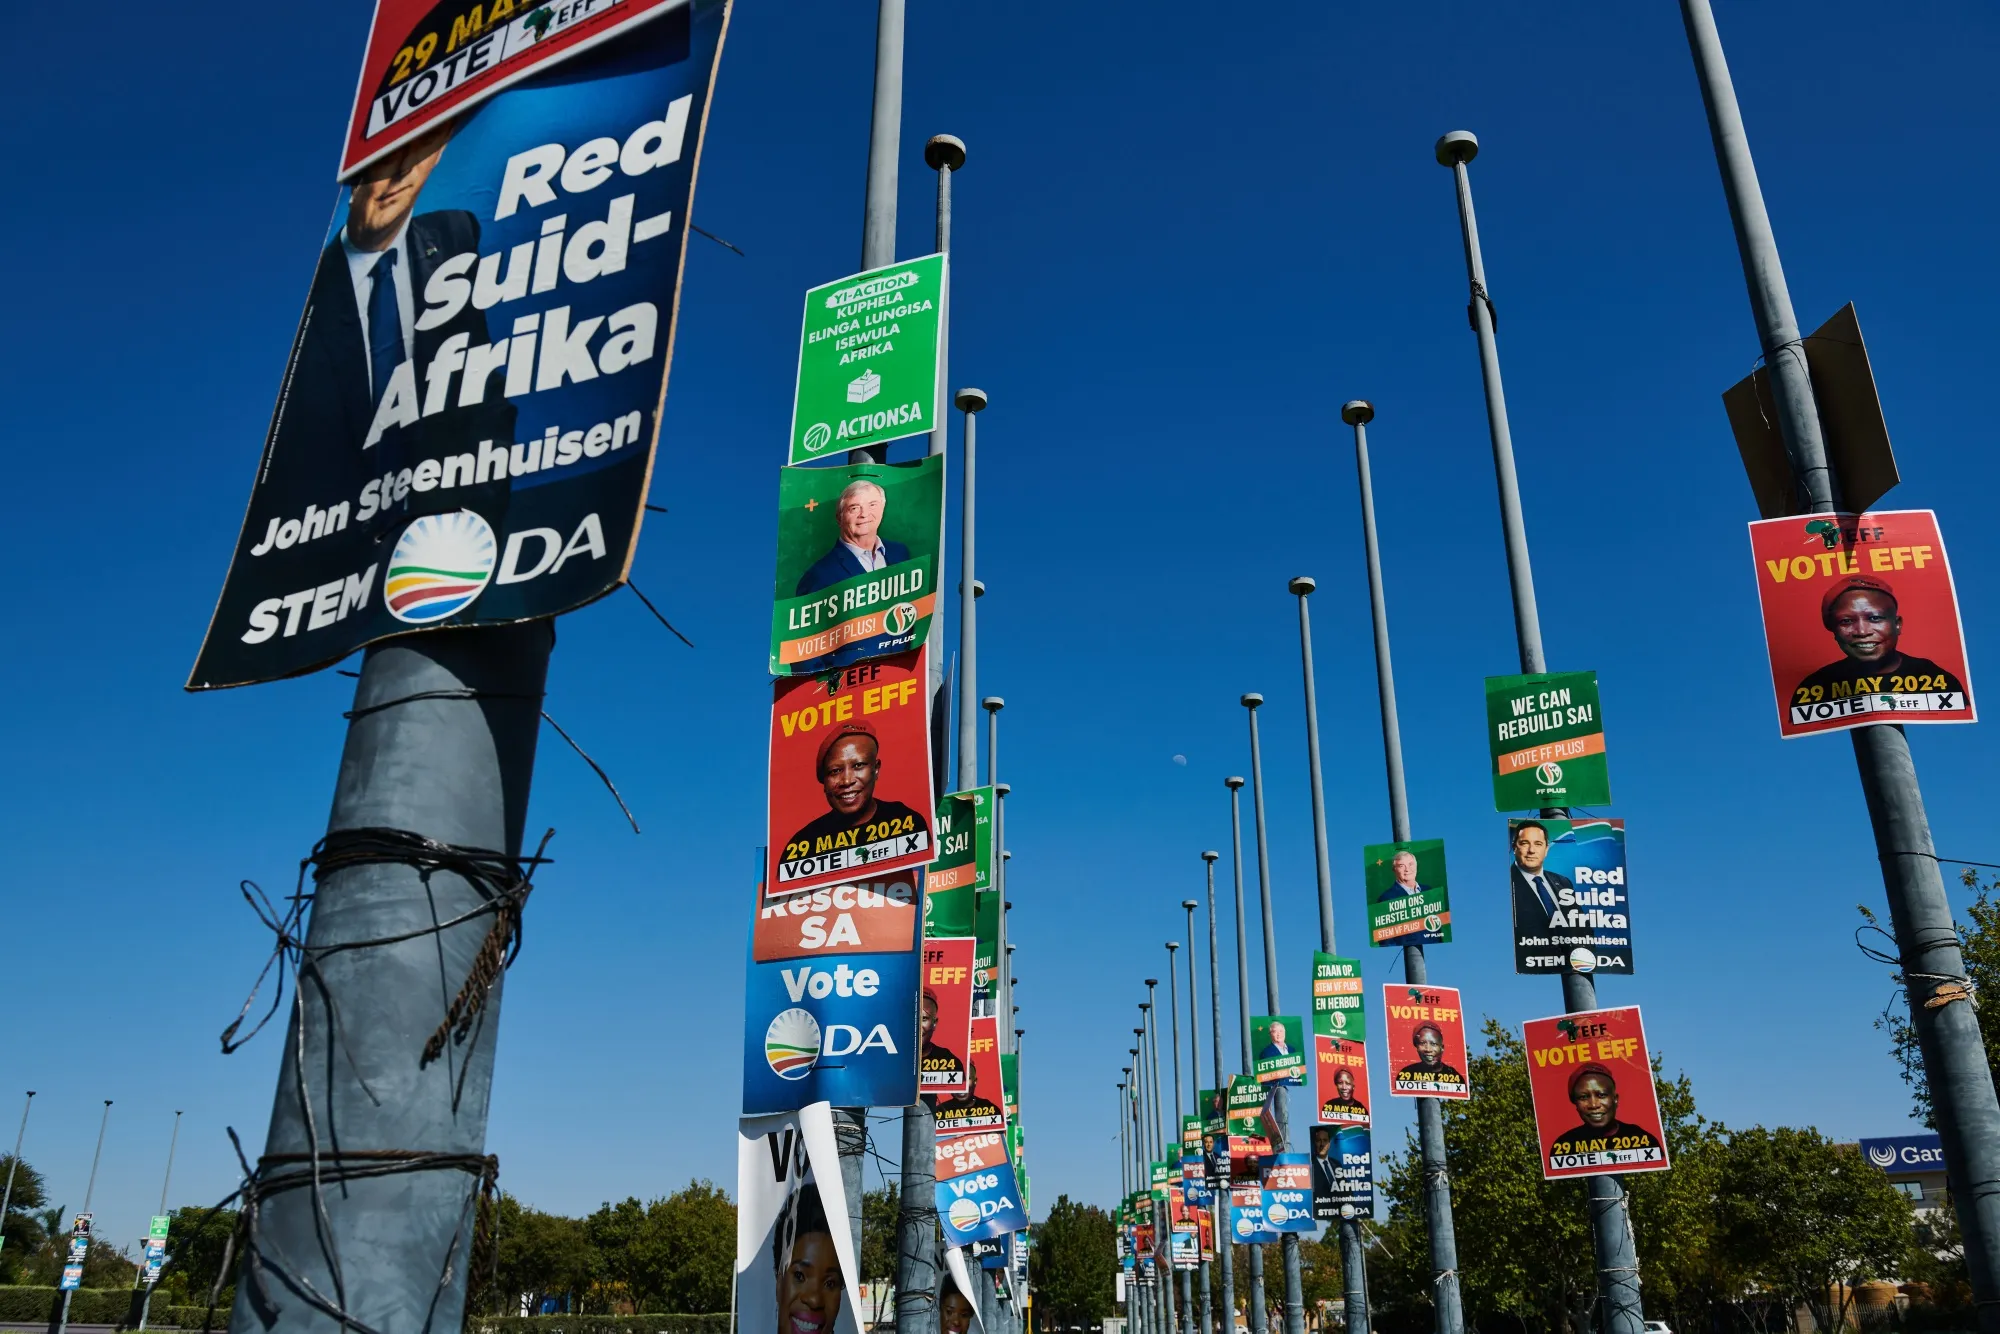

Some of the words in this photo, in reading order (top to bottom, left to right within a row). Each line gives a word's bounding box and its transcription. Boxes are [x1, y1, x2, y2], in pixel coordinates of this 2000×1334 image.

[388, 32, 438, 86] 29
[446, 0, 533, 53] MA
[381, 34, 495, 124] VOTE
[494, 93, 692, 221] Red
[414, 193, 671, 331] Suid-
[834, 274, 909, 304] YI-ACTION
[837, 292, 904, 319] KUPHELA
[808, 319, 860, 344] ELINGA
[865, 300, 932, 326] LUNGISA
[835, 324, 900, 351] ISEWULA
[839, 341, 893, 366] AFRIKA
[362, 301, 658, 450] Afrika
[836, 401, 922, 440] ACTIONSA
[356, 410, 642, 521] Steenhuisen
[250, 500, 350, 556] John
[1847, 527, 1884, 542] EFF
[1766, 551, 1859, 583] VOTE
[1869, 545, 1933, 572] EFF
[240, 564, 378, 645] STEM
[496, 512, 606, 585] DA
[788, 594, 838, 631] LET'S
[843, 568, 923, 612] REBUILD
[796, 635, 827, 657] VOTE
[829, 630, 840, 646] FF
[844, 617, 876, 640] PLUS!
[878, 640, 890, 649] FF
[892, 633, 916, 646] PLUS
[846, 665, 881, 686] EFF
[1796, 685, 1825, 704] 29
[1831, 675, 1884, 698] MAY
[1891, 674, 1947, 694] 2024
[780, 695, 853, 737] VOTE
[863, 678, 917, 715] EFF
[1511, 695, 1535, 717] WE
[1539, 688, 1571, 710] CAN
[1797, 698, 1865, 722] VOTE
[1900, 699, 1919, 709] EFF
[1498, 710, 1563, 741] REBUILD
[1566, 704, 1593, 725] SA!
[1510, 750, 1538, 768] VOTE
[1540, 746, 1552, 761] FF
[1555, 740, 1585, 757] PLUS!
[786, 840, 810, 861] 29
[815, 830, 859, 853] MAY
[866, 815, 914, 842] 2024
[946, 832, 969, 855] SA!
[784, 852, 842, 879] VOTE
[872, 846, 889, 860] EFF
[929, 871, 958, 889] PLUS!
[1575, 866, 1624, 885] Red
[1388, 899, 1407, 912] KOM
[1408, 894, 1424, 907] ONS
[1558, 888, 1625, 906] Suid-
[1375, 910, 1409, 927] HERSTEL
[1411, 906, 1422, 918] EN
[1423, 901, 1442, 915] BOU!
[1549, 909, 1627, 929] Afrika
[798, 913, 861, 949] SA
[1378, 926, 1394, 939] STEM
[1395, 924, 1402, 934] VF
[1403, 921, 1420, 933] PLUS!
[1519, 936, 1549, 946] John
[1551, 935, 1627, 946] Steenhuisen
[1525, 955, 1565, 967] STEM
[1596, 955, 1625, 967] DA
[930, 967, 967, 985] EFF
[1317, 965, 1341, 977] STAAN
[1342, 965, 1354, 977] OP,
[780, 964, 880, 1003] Vote
[1315, 982, 1333, 992] STEM
[1343, 981, 1358, 990] PLUS
[1316, 998, 1326, 1010] EN
[1327, 996, 1360, 1009] HERBOU
[1424, 995, 1441, 1004] EFF
[1390, 1005, 1429, 1020] VOTE
[1433, 1008, 1459, 1022] EFF
[1581, 1023, 1607, 1037] EFF
[823, 1023, 898, 1057] DA
[1341, 1044, 1352, 1053] EFF
[1318, 1051, 1345, 1065] VOTE
[1347, 1054, 1365, 1068] EFF
[1533, 1043, 1592, 1068] VOTE
[1597, 1037, 1639, 1060] EFF
[923, 1059, 956, 1071] 2024
[1257, 1060, 1275, 1072] LET'S
[1275, 1055, 1301, 1068] REBUILD
[925, 1075, 938, 1083] EFF
[1398, 1071, 1411, 1081] 29
[1413, 1072, 1435, 1082] MAY
[1437, 1073, 1460, 1083] 2024
[1398, 1081, 1428, 1090] VOTE
[1237, 1085, 1247, 1095] WE
[1248, 1084, 1262, 1093] CAN
[1230, 1093, 1257, 1105] REBUILD
[945, 1109, 967, 1119] MAY
[970, 1106, 995, 1117] 2024
[1323, 1104, 1333, 1112] 29
[1334, 1105, 1349, 1113] MAY
[1231, 1144, 1255, 1152] VOTE
[1553, 1141, 1571, 1155] 29
[1575, 1138, 1608, 1153] MAY
[1613, 1134, 1650, 1150] 2024
[953, 1151, 984, 1173] SA
[1342, 1152, 1370, 1165] Red
[1554, 1153, 1597, 1168] VOTE
[1619, 1154, 1632, 1162] EFF
[1263, 1168, 1309, 1178] Rescue
[1334, 1166, 1371, 1178] Suid-
[949, 1173, 998, 1198] Vote
[1276, 1177, 1297, 1188] SA
[1330, 1179, 1371, 1192] Afrika
[1244, 1195, 1260, 1206] SA
[1272, 1191, 1304, 1203] Vote
[980, 1196, 1014, 1217] DA
[1288, 1208, 1311, 1219] DA
[1318, 1208, 1340, 1216] STEM
[1354, 1207, 1370, 1215] DA
[982, 1245, 997, 1253] DA
